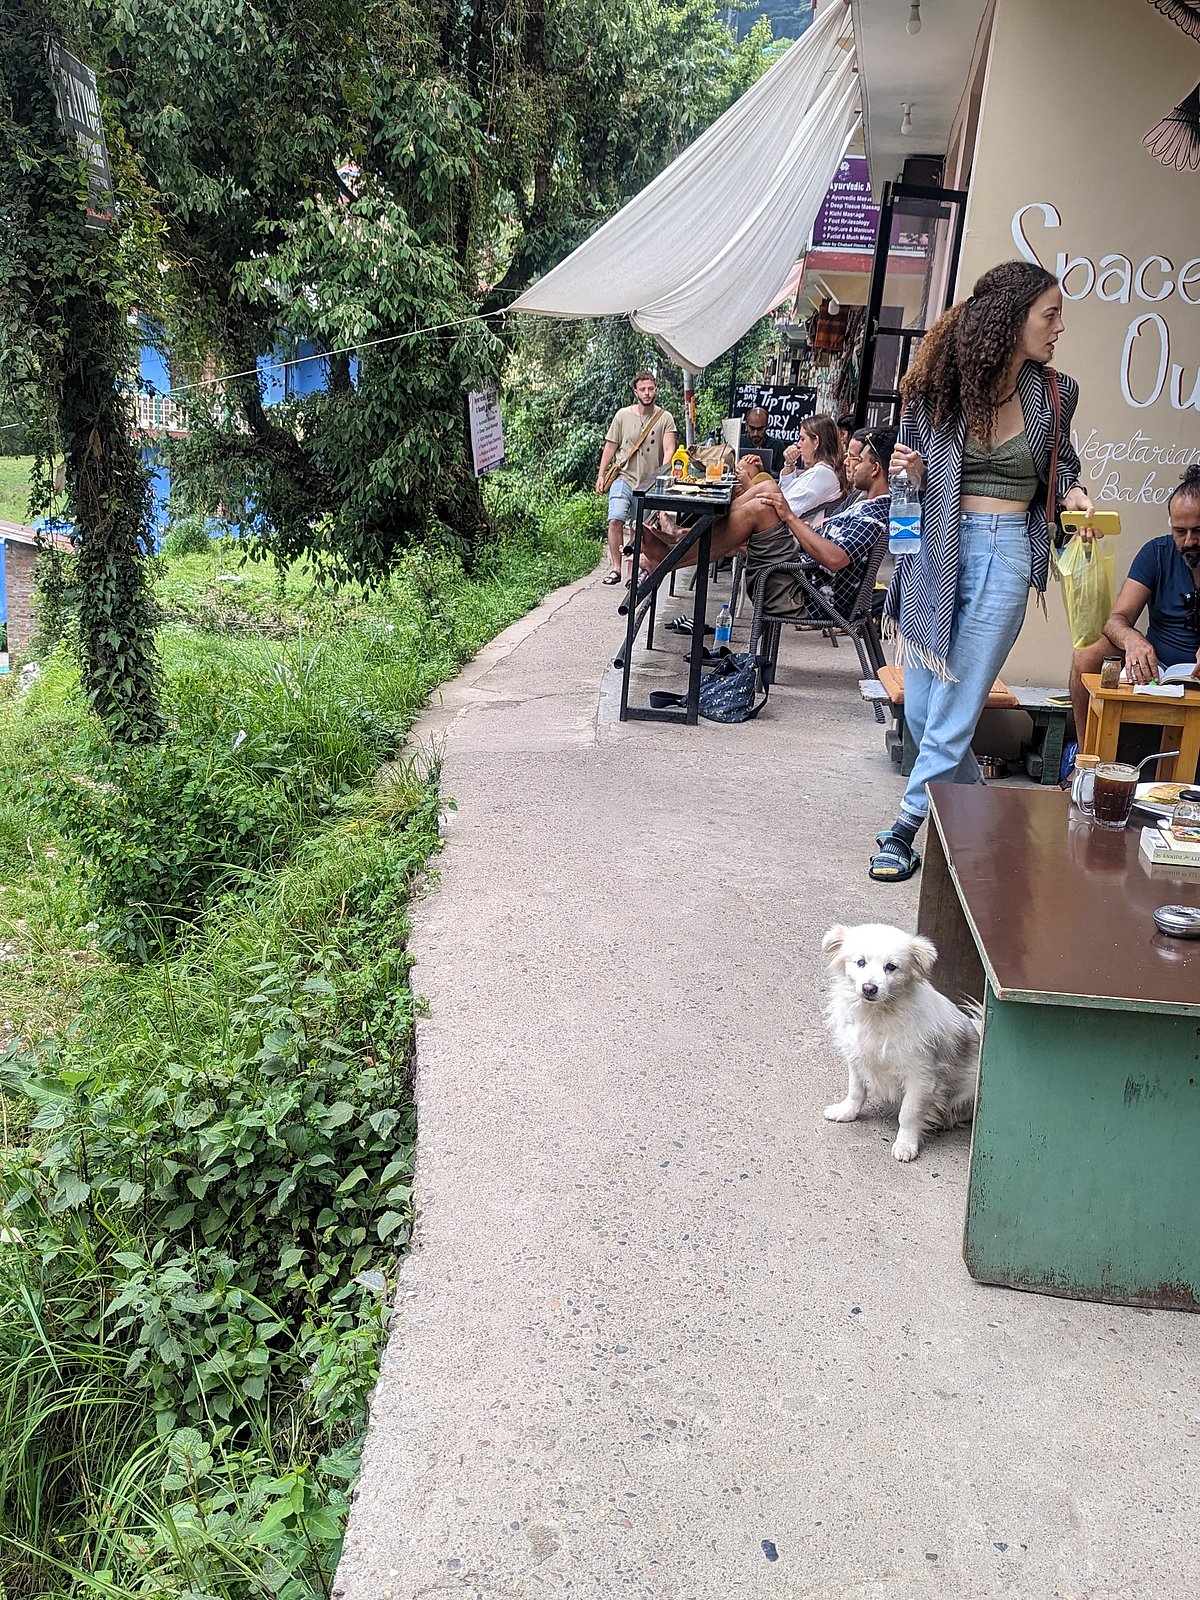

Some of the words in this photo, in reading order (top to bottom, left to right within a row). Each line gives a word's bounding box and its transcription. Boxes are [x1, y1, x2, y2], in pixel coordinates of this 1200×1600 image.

[861, 204, 881, 212] Massag
[741, 413, 789, 430] LDRY
[1095, 471, 1174, 504] Baker
